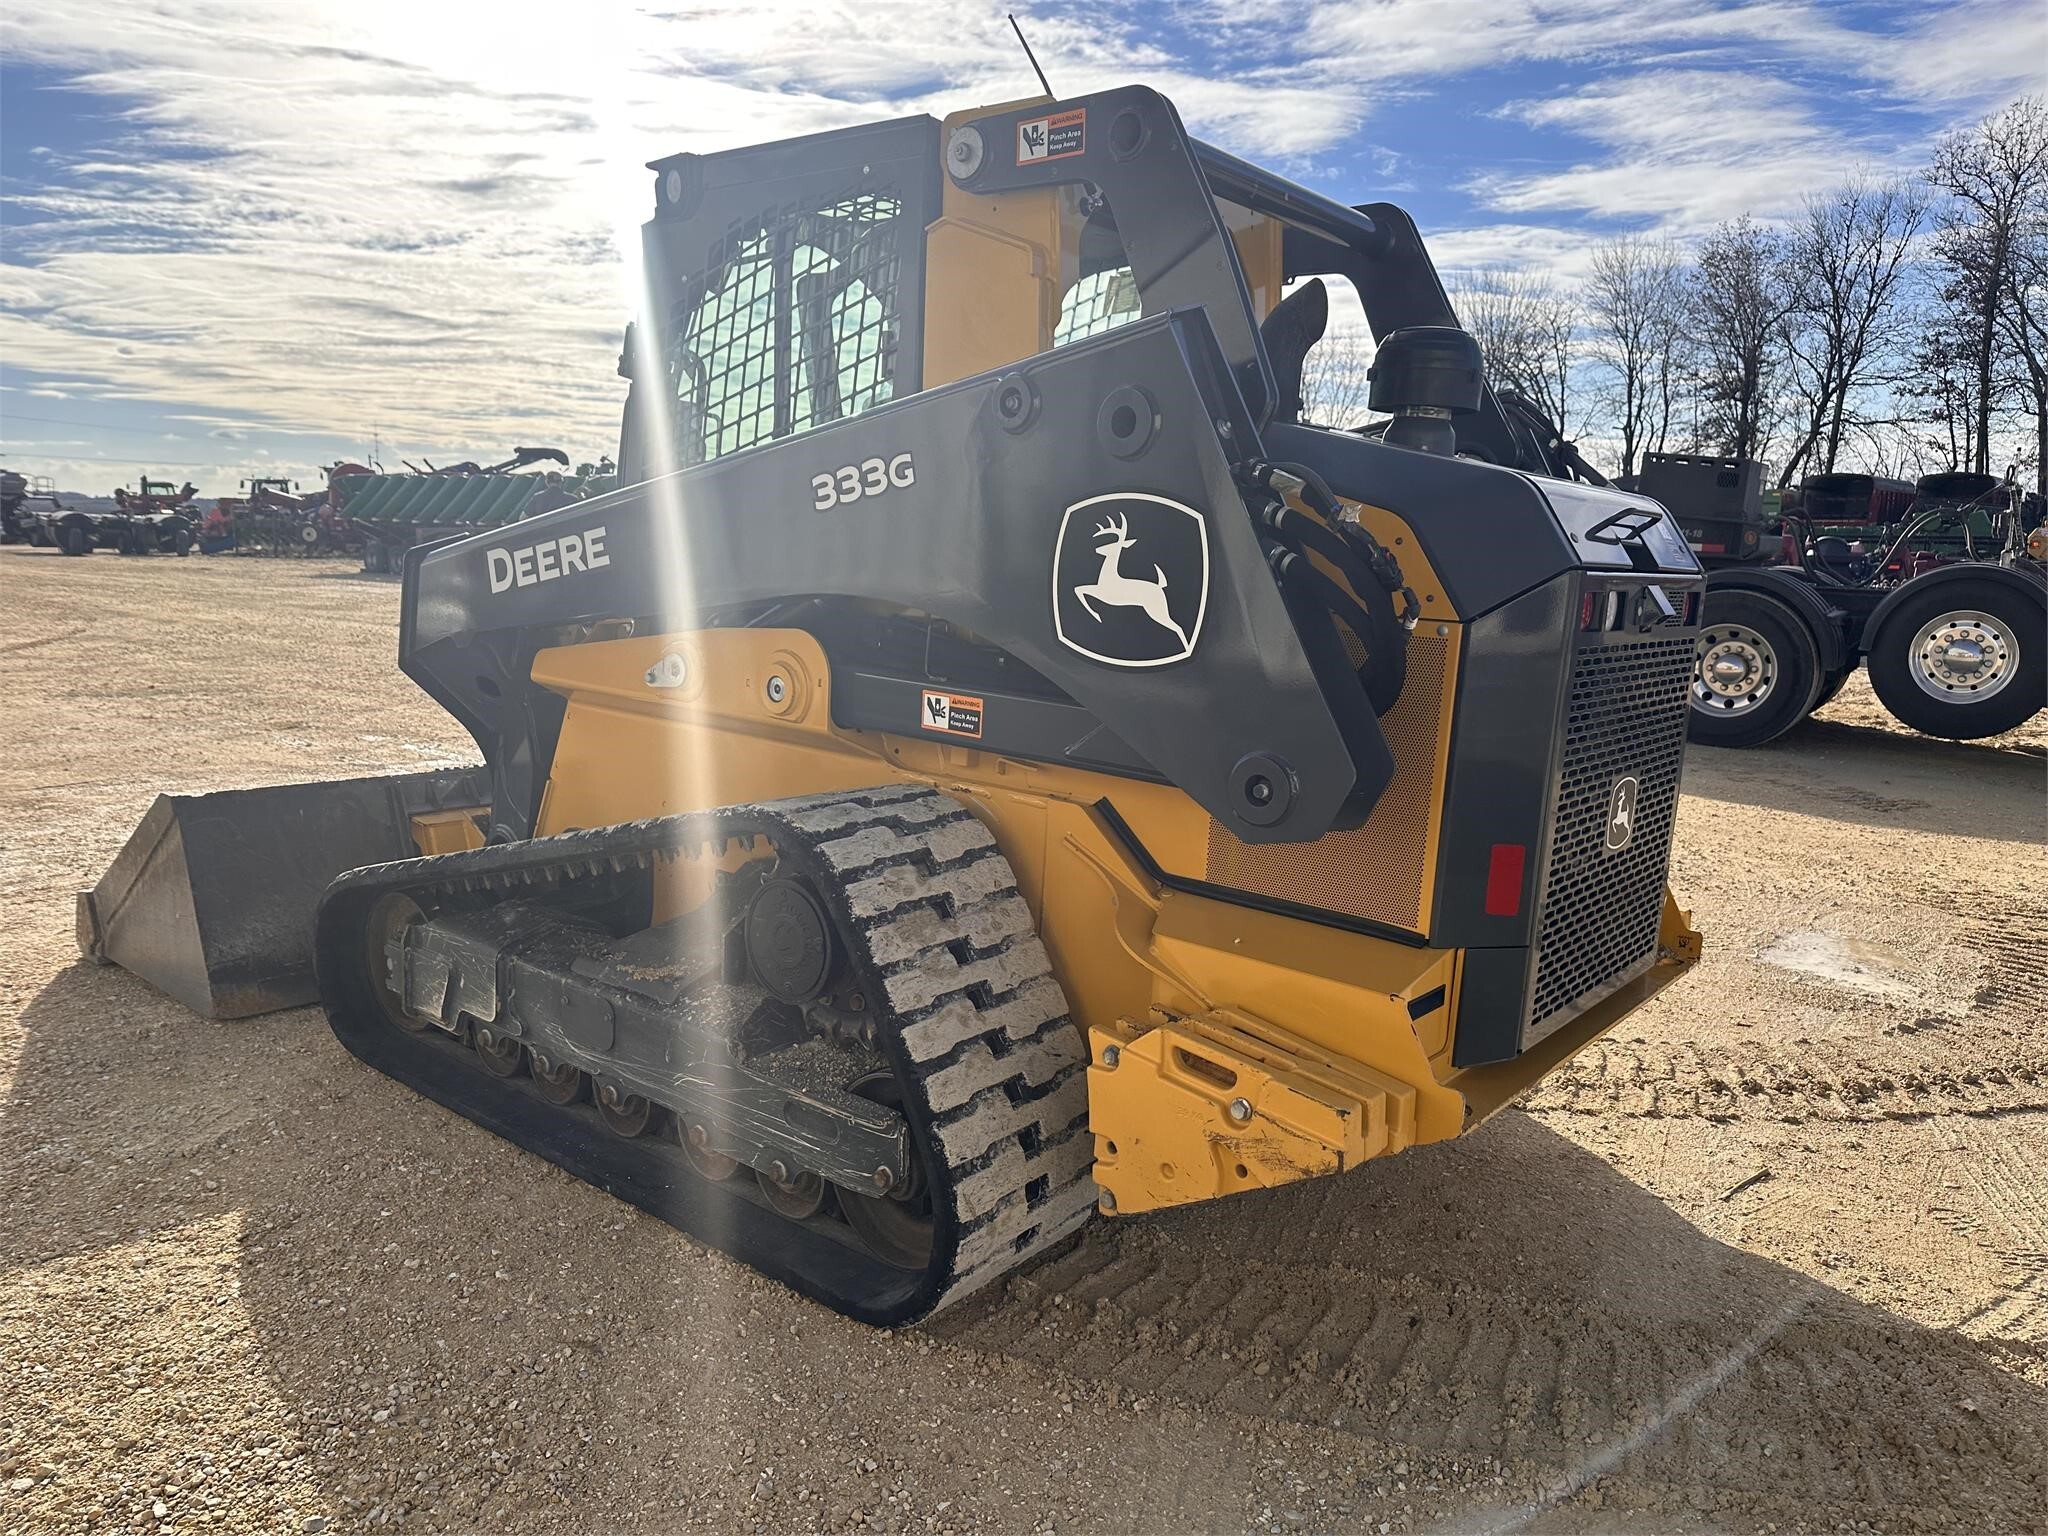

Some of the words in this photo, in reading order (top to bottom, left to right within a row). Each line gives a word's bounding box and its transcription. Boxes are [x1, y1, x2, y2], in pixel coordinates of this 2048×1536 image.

[1055, 113, 1083, 123] WARNING
[1050, 132, 1067, 141] Pinch
[1067, 130, 1081, 138] Area
[812, 453, 915, 510] 333G
[486, 526, 611, 594] DEERE
[956, 699, 980, 708] WARNING
[950, 711, 965, 720] Pinch
[965, 714, 979, 722] Area
[950, 720, 962, 728] Keep
[961, 722, 974, 730] Away
